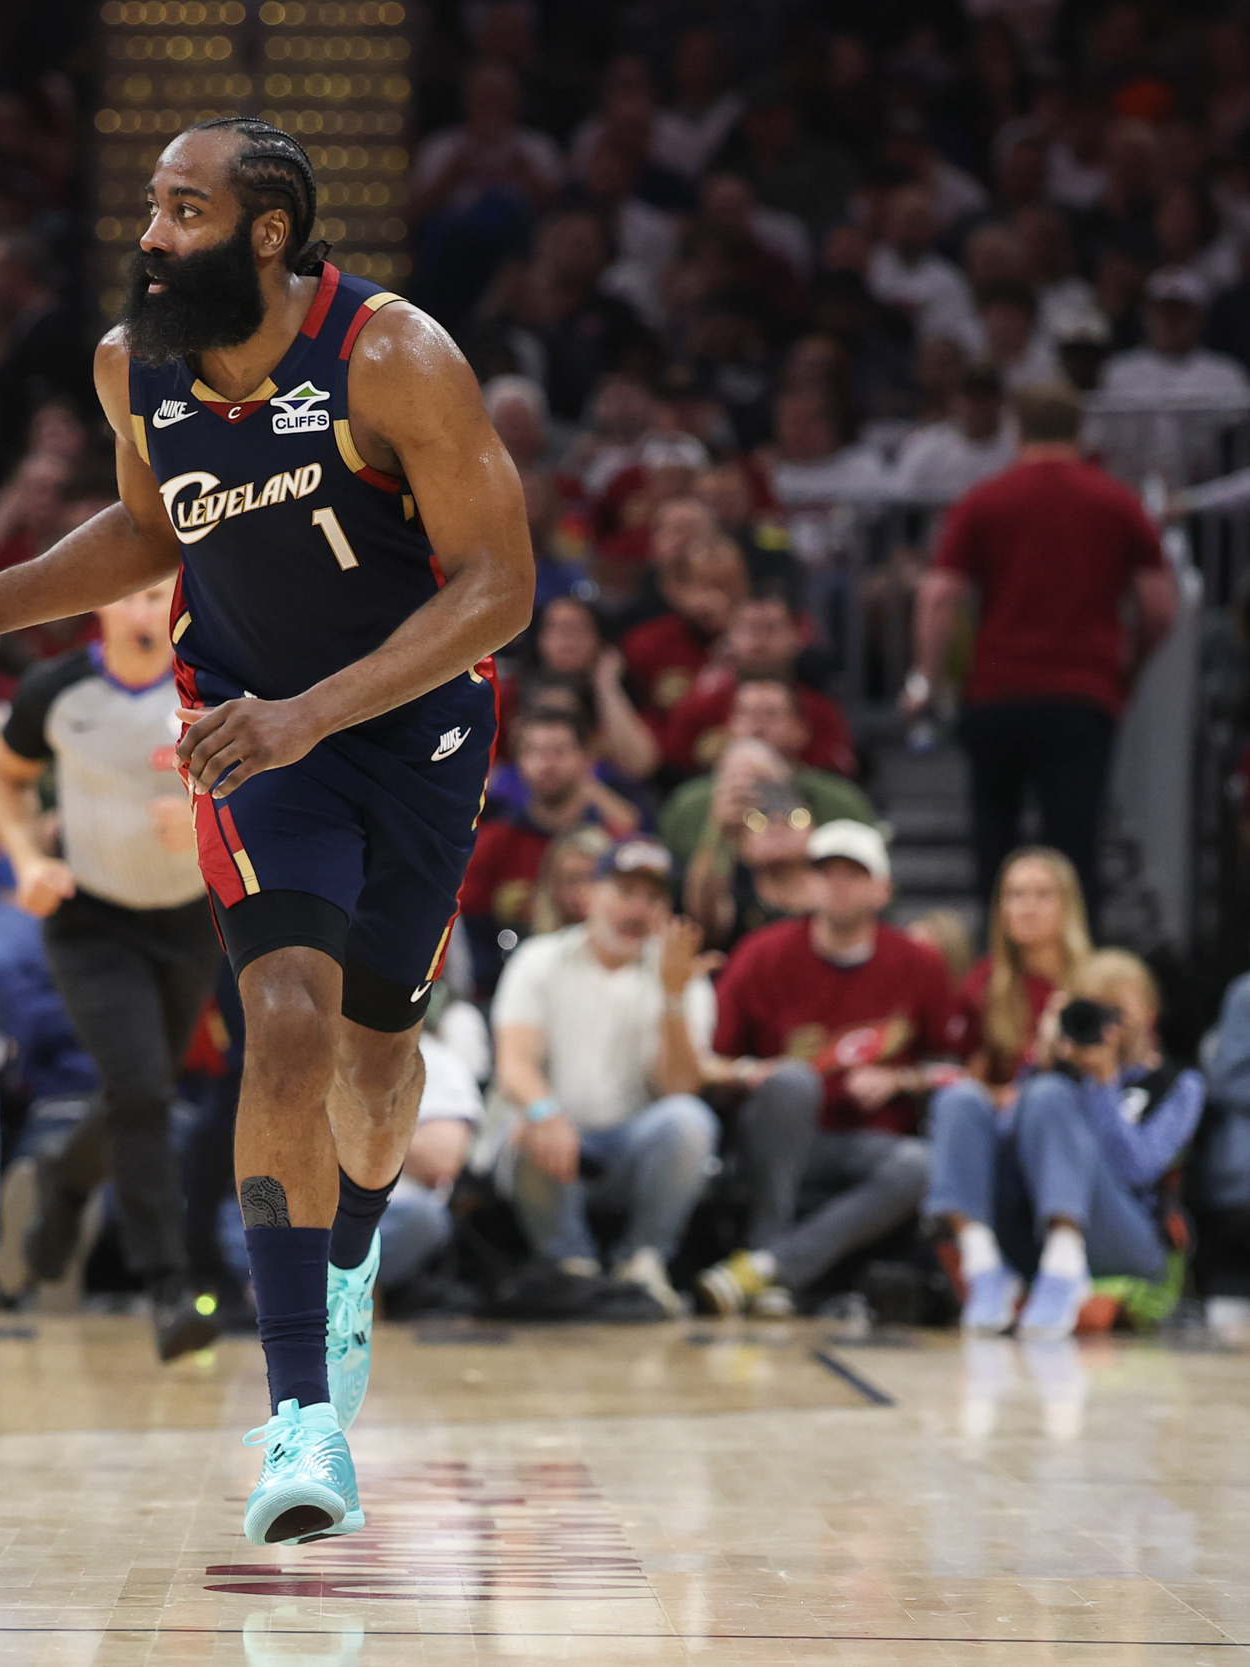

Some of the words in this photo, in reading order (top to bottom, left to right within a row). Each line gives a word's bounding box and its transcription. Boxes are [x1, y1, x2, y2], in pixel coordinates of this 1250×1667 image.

[159, 400, 187, 418] NIKE
[275, 414, 328, 430] CLIFFS
[159, 462, 323, 545] CLEVELAND
[311, 506, 360, 572] 1
[439, 726, 462, 753] NIKE
